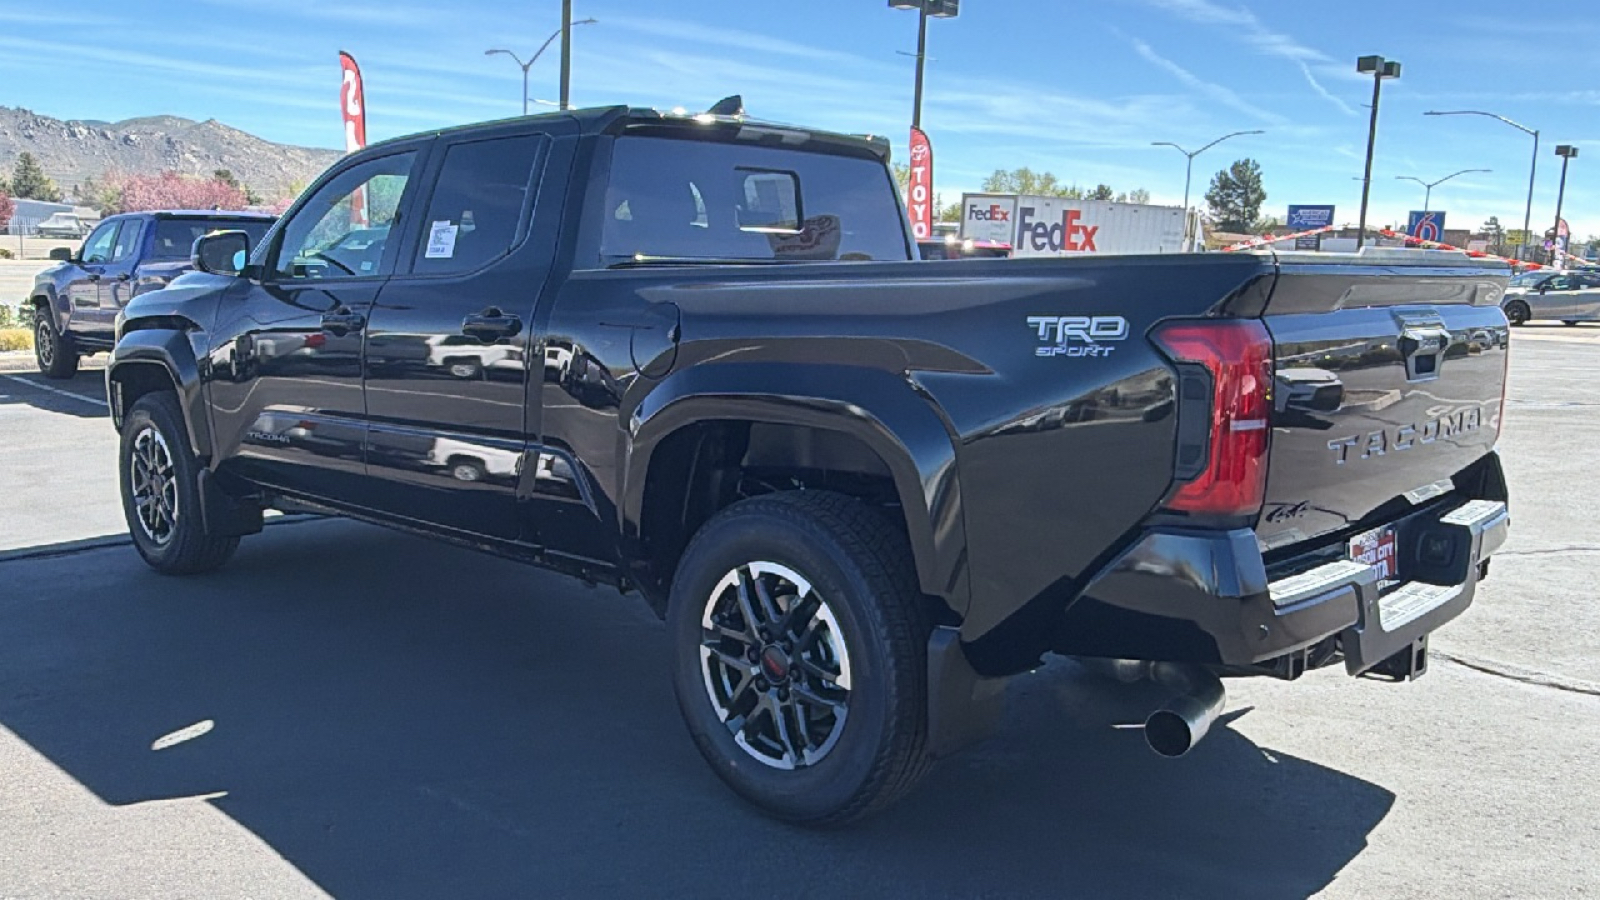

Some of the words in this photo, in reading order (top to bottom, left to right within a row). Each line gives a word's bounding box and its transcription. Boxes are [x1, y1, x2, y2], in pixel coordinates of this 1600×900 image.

[968, 204, 1010, 221] FedEx
[1017, 207, 1099, 252] FedEx
[1414, 212, 1438, 241] 6
[1027, 316, 1129, 343] TRD
[1035, 346, 1115, 357] SPORT
[247, 432, 290, 443] TACOMA
[1327, 407, 1481, 465] TACOMA
[1378, 543, 1394, 561] CITY
